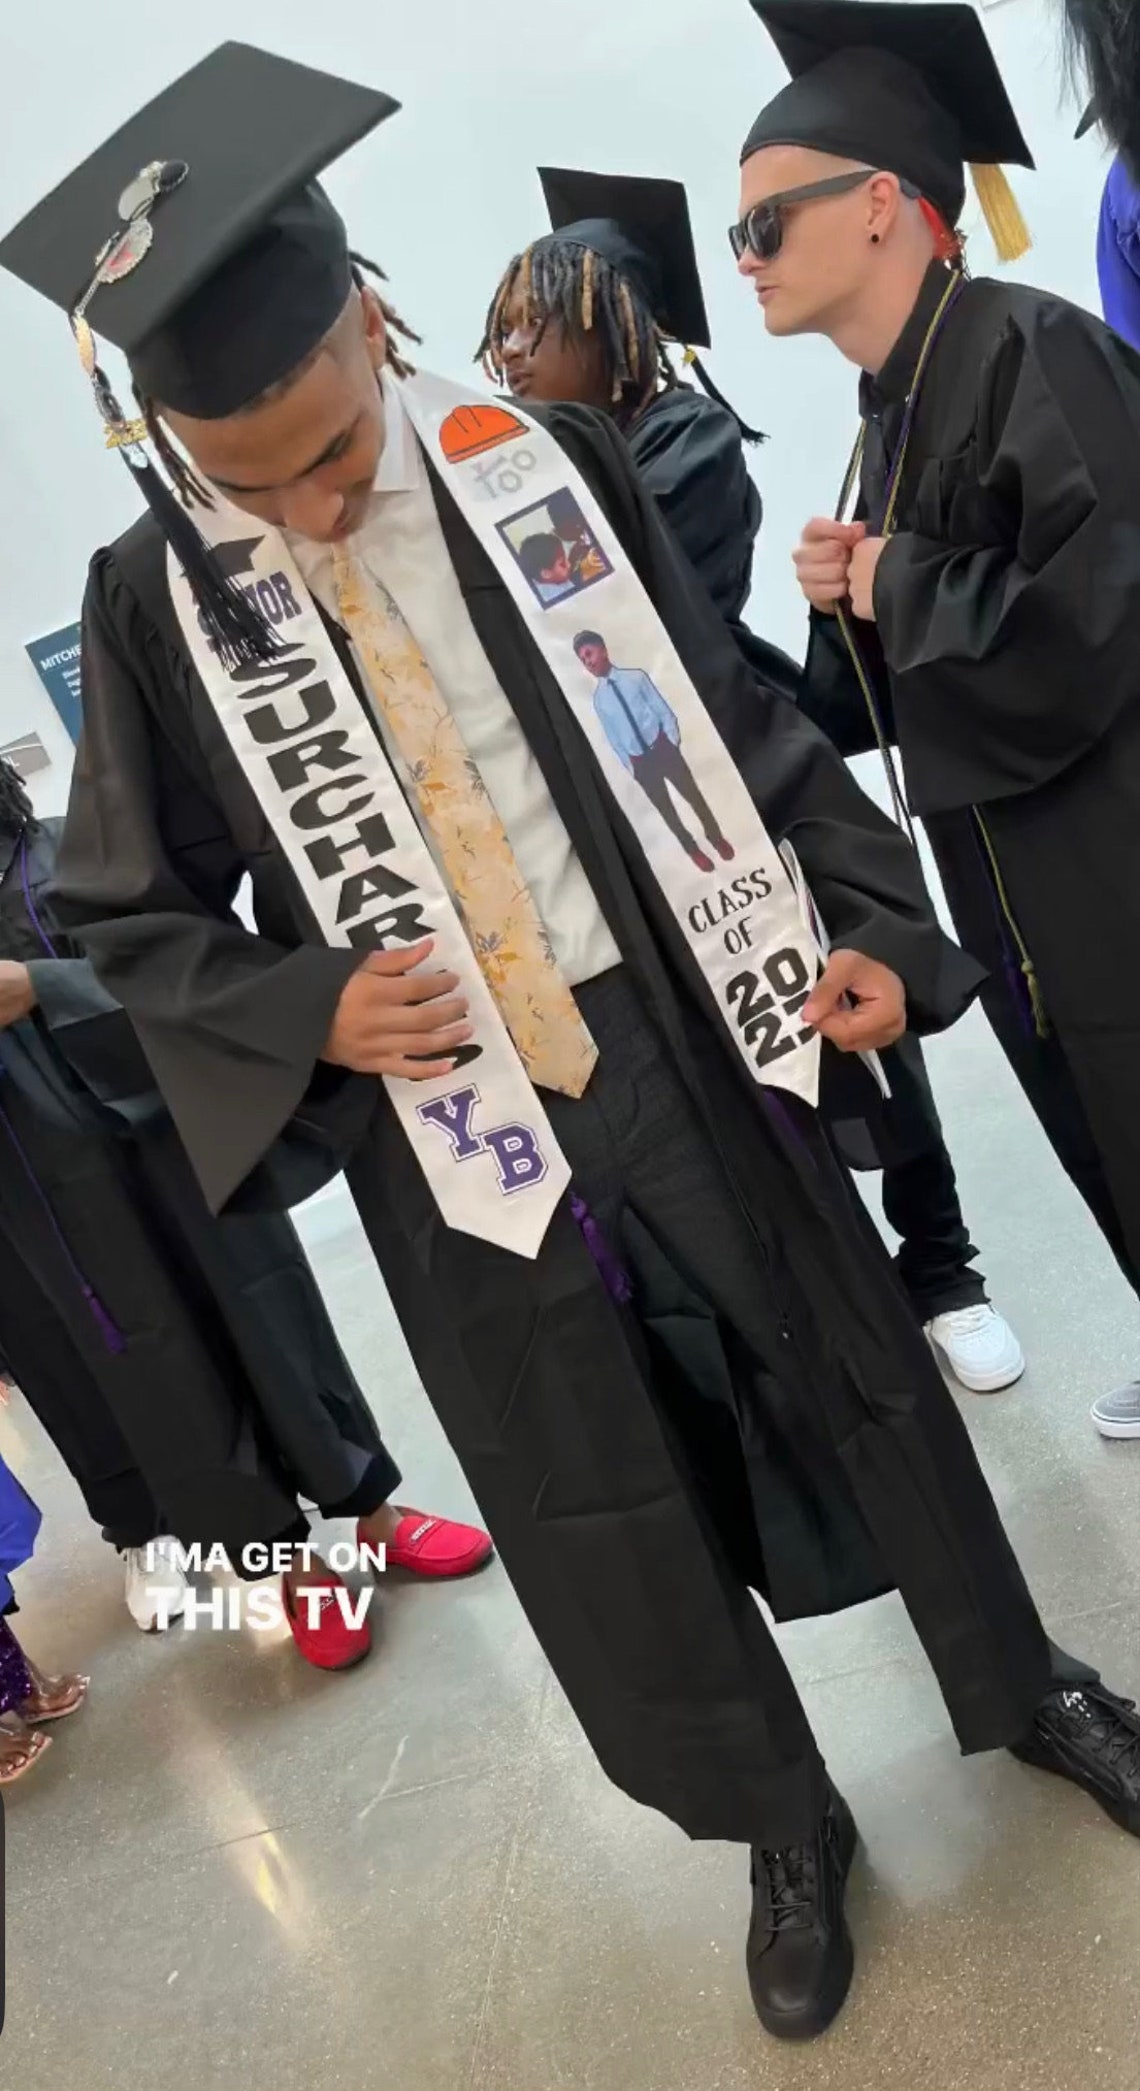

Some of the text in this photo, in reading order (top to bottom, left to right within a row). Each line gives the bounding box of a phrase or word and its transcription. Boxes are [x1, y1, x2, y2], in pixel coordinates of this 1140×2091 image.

[688, 868, 773, 933] CLASS
[723, 916, 752, 955] OF
[725, 947, 810, 1029] 20
